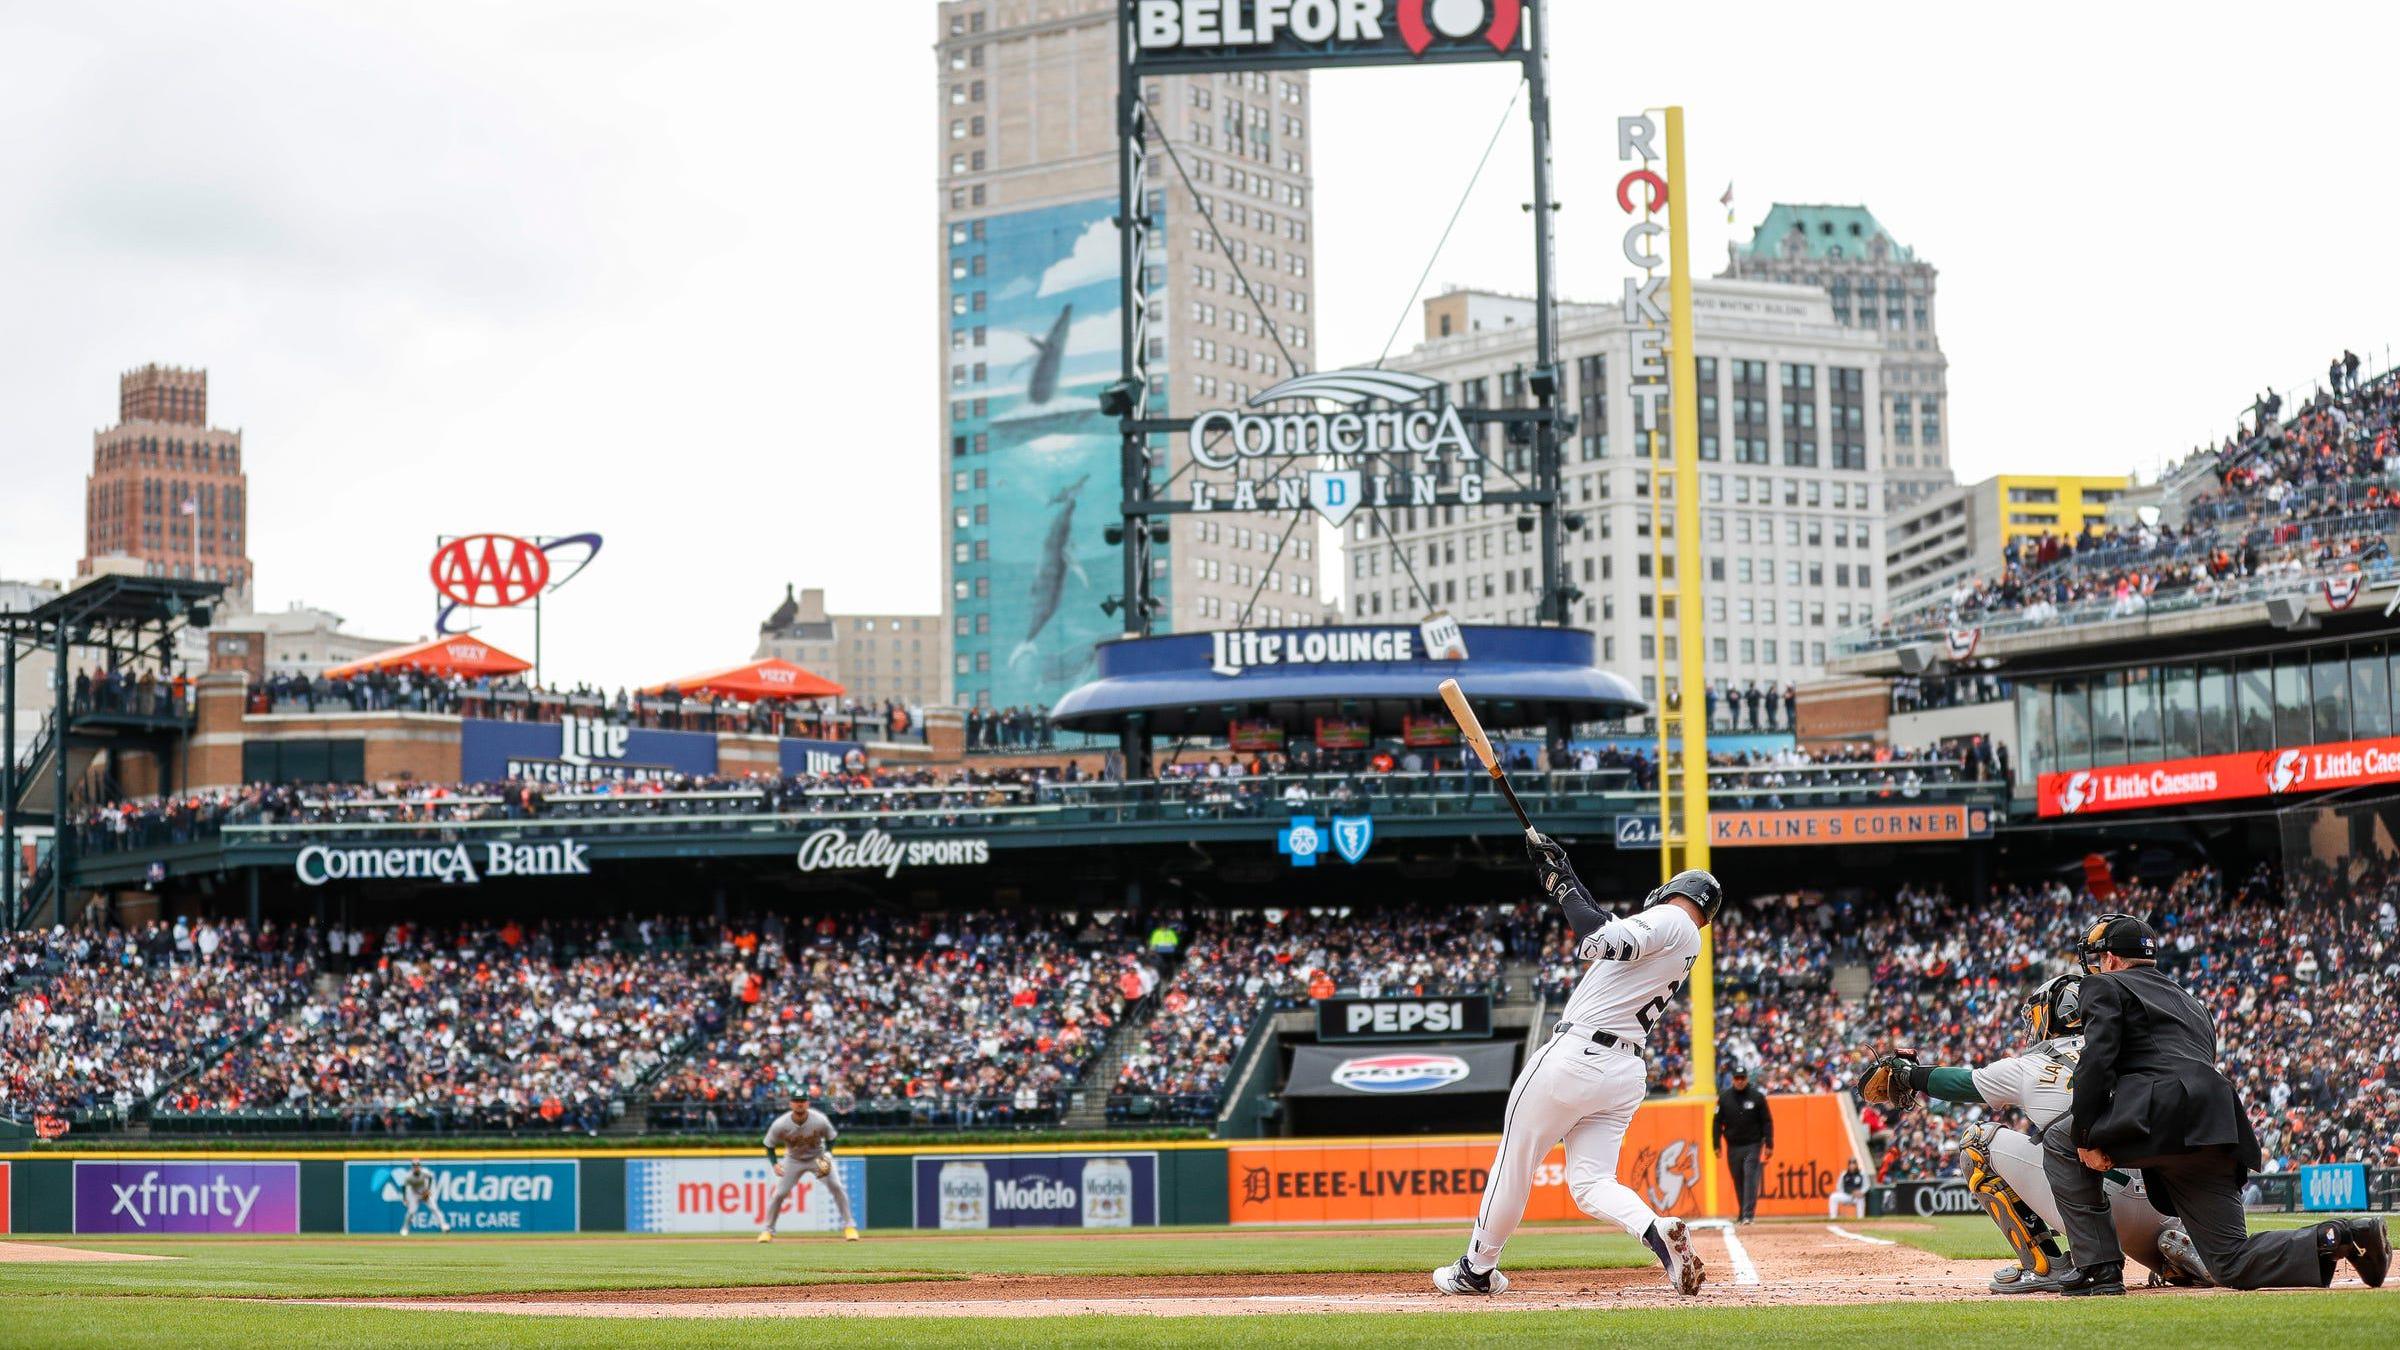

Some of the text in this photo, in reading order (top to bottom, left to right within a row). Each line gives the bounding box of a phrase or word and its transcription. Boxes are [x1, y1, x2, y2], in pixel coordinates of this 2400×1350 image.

[1138, 0, 1384, 49] BELFOR
[438, 536, 541, 606] AAA
[1211, 631, 1412, 676] Lite LOUNGE
[758, 668, 797, 684] VIZZY
[560, 714, 630, 765] Lite
[806, 750, 843, 777] Lite
[2314, 751, 2362, 781] Little
[2103, 770, 2217, 800] Little Caesars
[1718, 812, 1959, 838] KALINE'S CORNER
[485, 838, 590, 876] Bank
[798, 828, 989, 879] Bally SPORTS
[1346, 1003, 1463, 1033] PEPSI
[435, 1169, 554, 1202] McLaren
[943, 1180, 984, 1199] Modelo
[994, 1179, 1077, 1210] Modelo
[1086, 1177, 1128, 1197] Modelo
[1759, 1160, 1833, 1200] Little
[111, 1171, 261, 1228] xfinity
[475, 1211, 521, 1229] CARE
